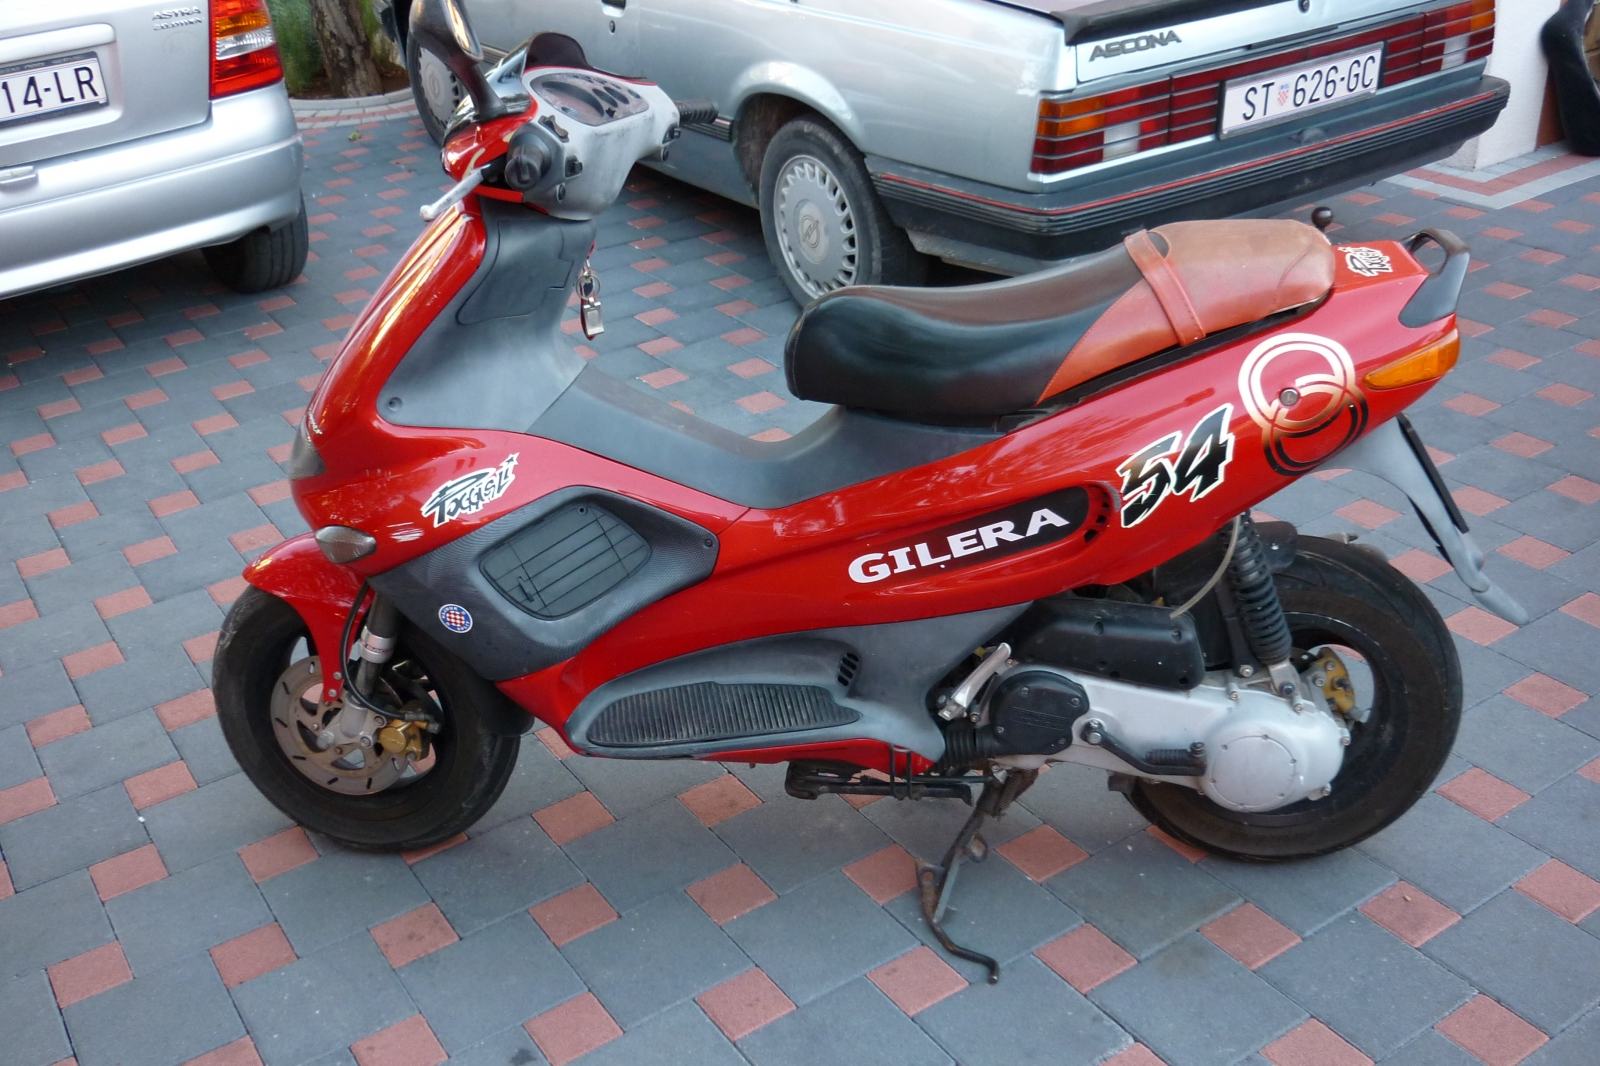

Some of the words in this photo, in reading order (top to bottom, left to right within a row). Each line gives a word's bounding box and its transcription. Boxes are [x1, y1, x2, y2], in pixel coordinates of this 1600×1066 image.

[1088, 30, 1182, 61] ASCONA
[1242, 81, 1275, 121] ST
[1293, 55, 1376, 107] 626-GC
[1115, 402, 1235, 528] 54
[848, 508, 1070, 584] GILERA
